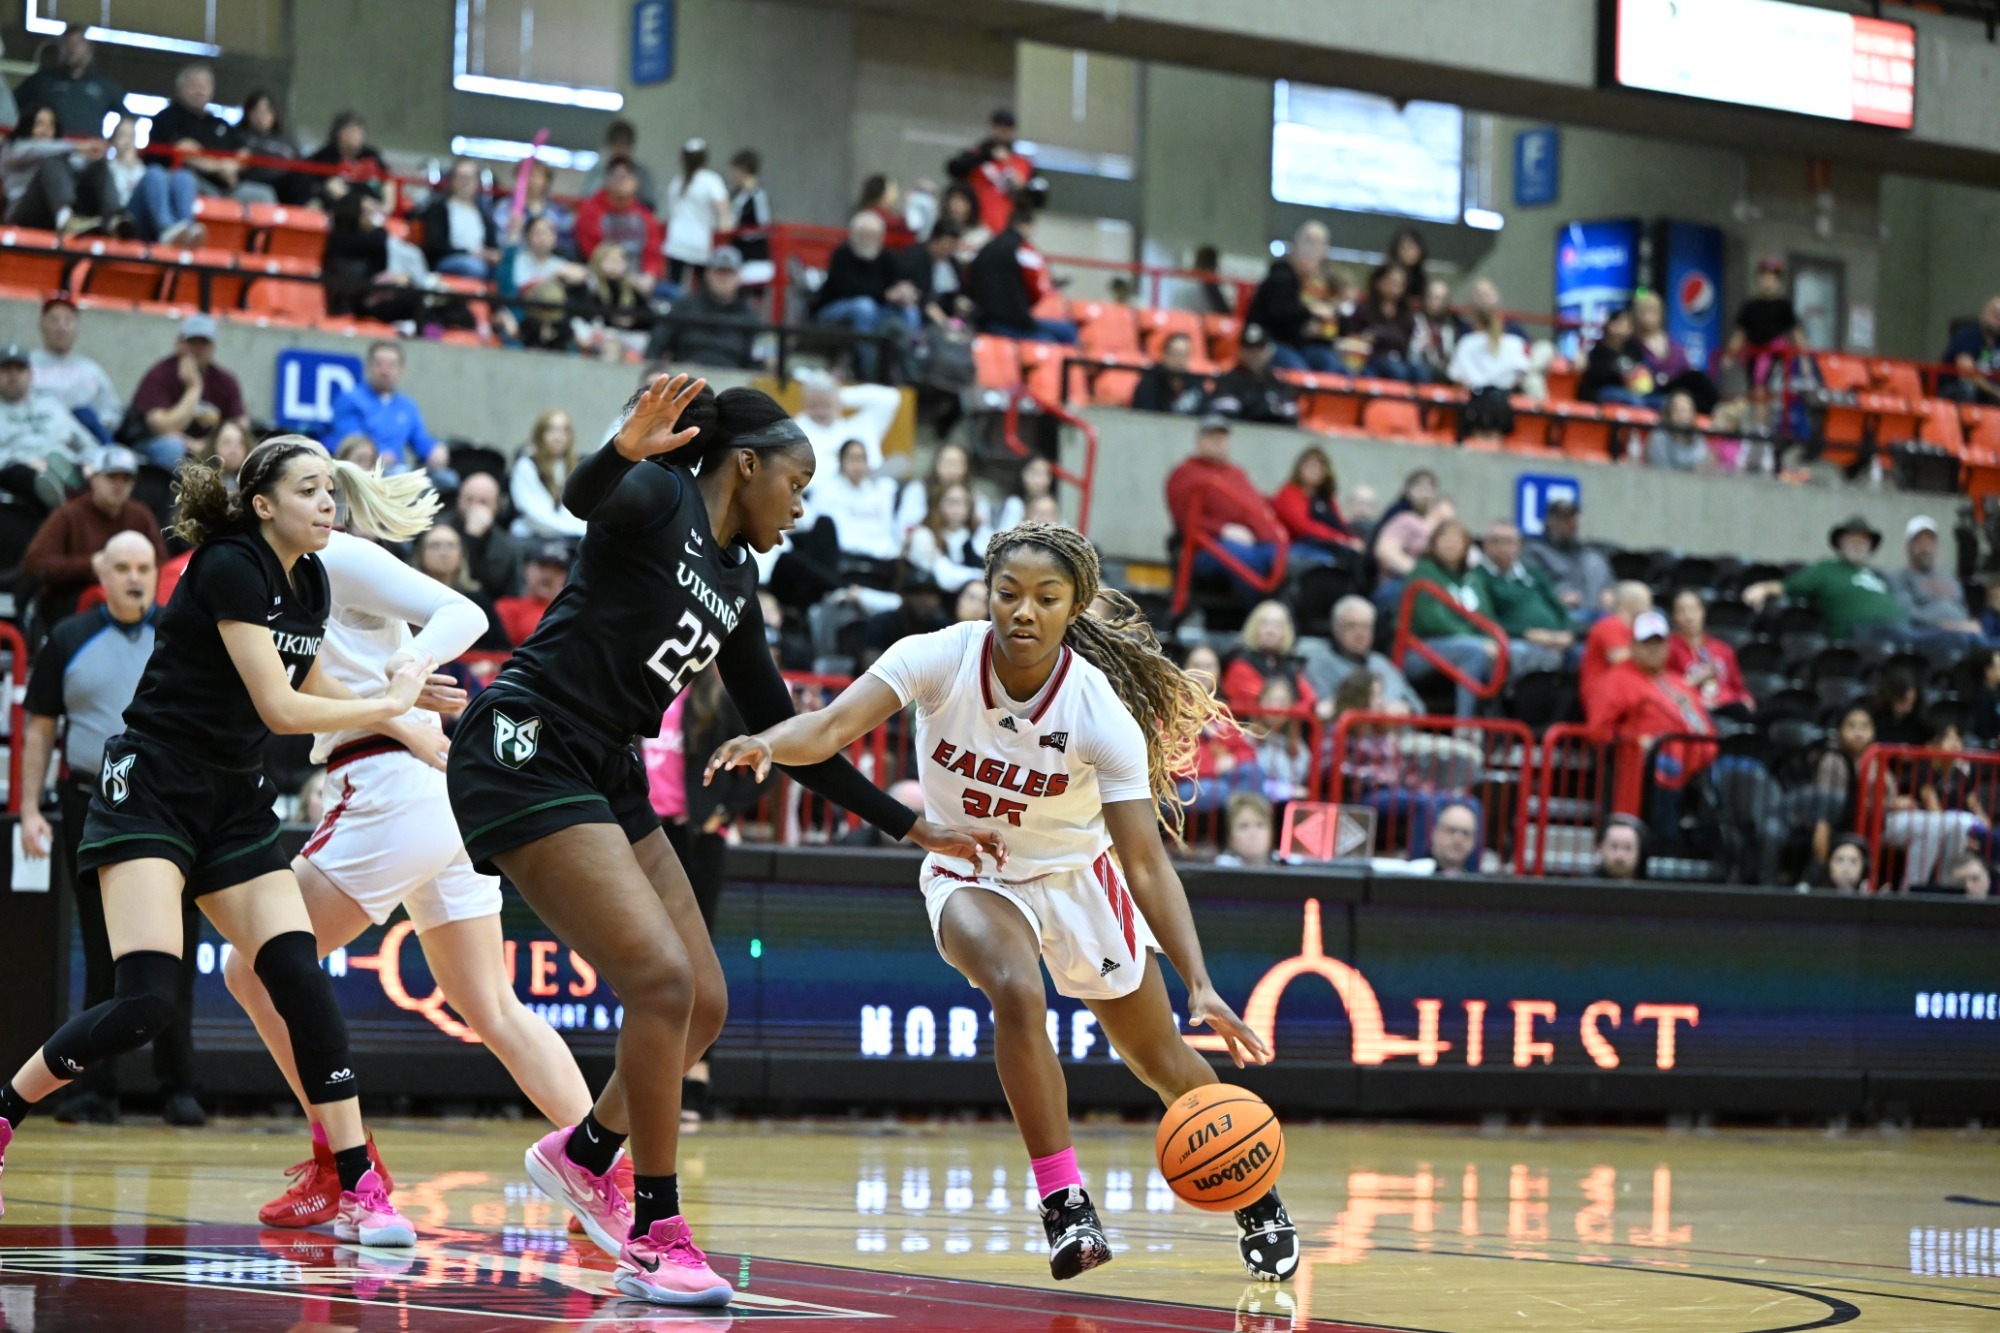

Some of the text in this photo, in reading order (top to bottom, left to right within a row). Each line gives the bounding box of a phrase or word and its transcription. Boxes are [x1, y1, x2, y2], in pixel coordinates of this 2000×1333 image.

[646, 608, 721, 694] 22
[931, 738, 1069, 797] EAGLES
[1915, 990, 2000, 1020] NORTHE
[1188, 1114, 1233, 1152] EVO
[1192, 1141, 1272, 1191] Wilson
